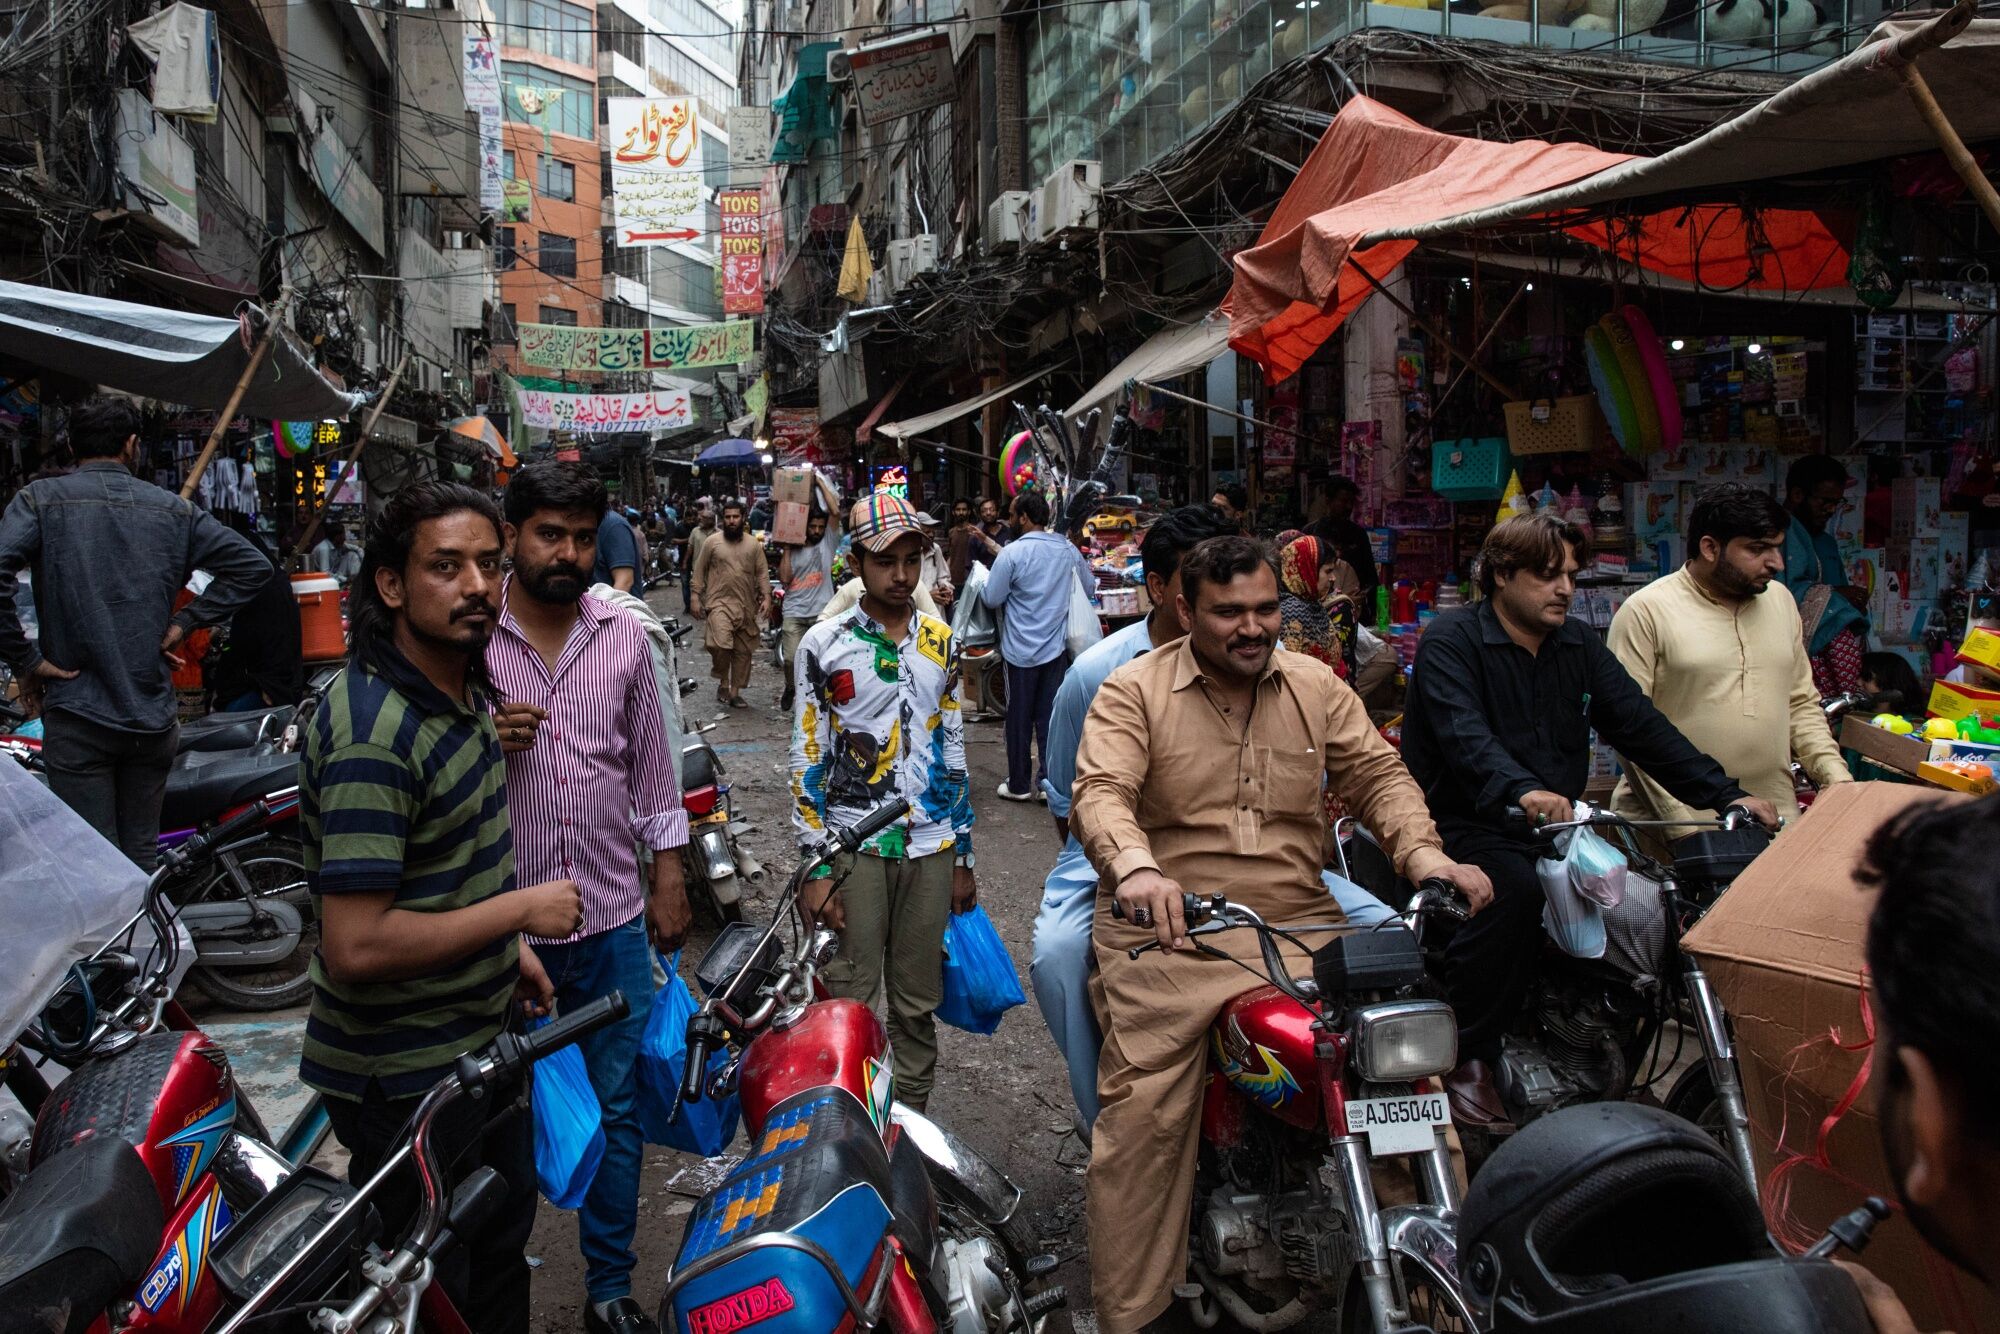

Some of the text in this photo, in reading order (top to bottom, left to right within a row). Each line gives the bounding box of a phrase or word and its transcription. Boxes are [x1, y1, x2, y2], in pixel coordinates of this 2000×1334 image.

[615, 102, 662, 165] ٹوائے
[661, 99, 698, 168] الفتح
[722, 196, 759, 213] TOYS
[723, 217, 760, 233] TOYS
[724, 238, 761, 254] TOYS
[1366, 1099, 1443, 1125] AJG5040
[141, 1254, 182, 1309] CD70
[690, 1278, 791, 1334] HONDA
